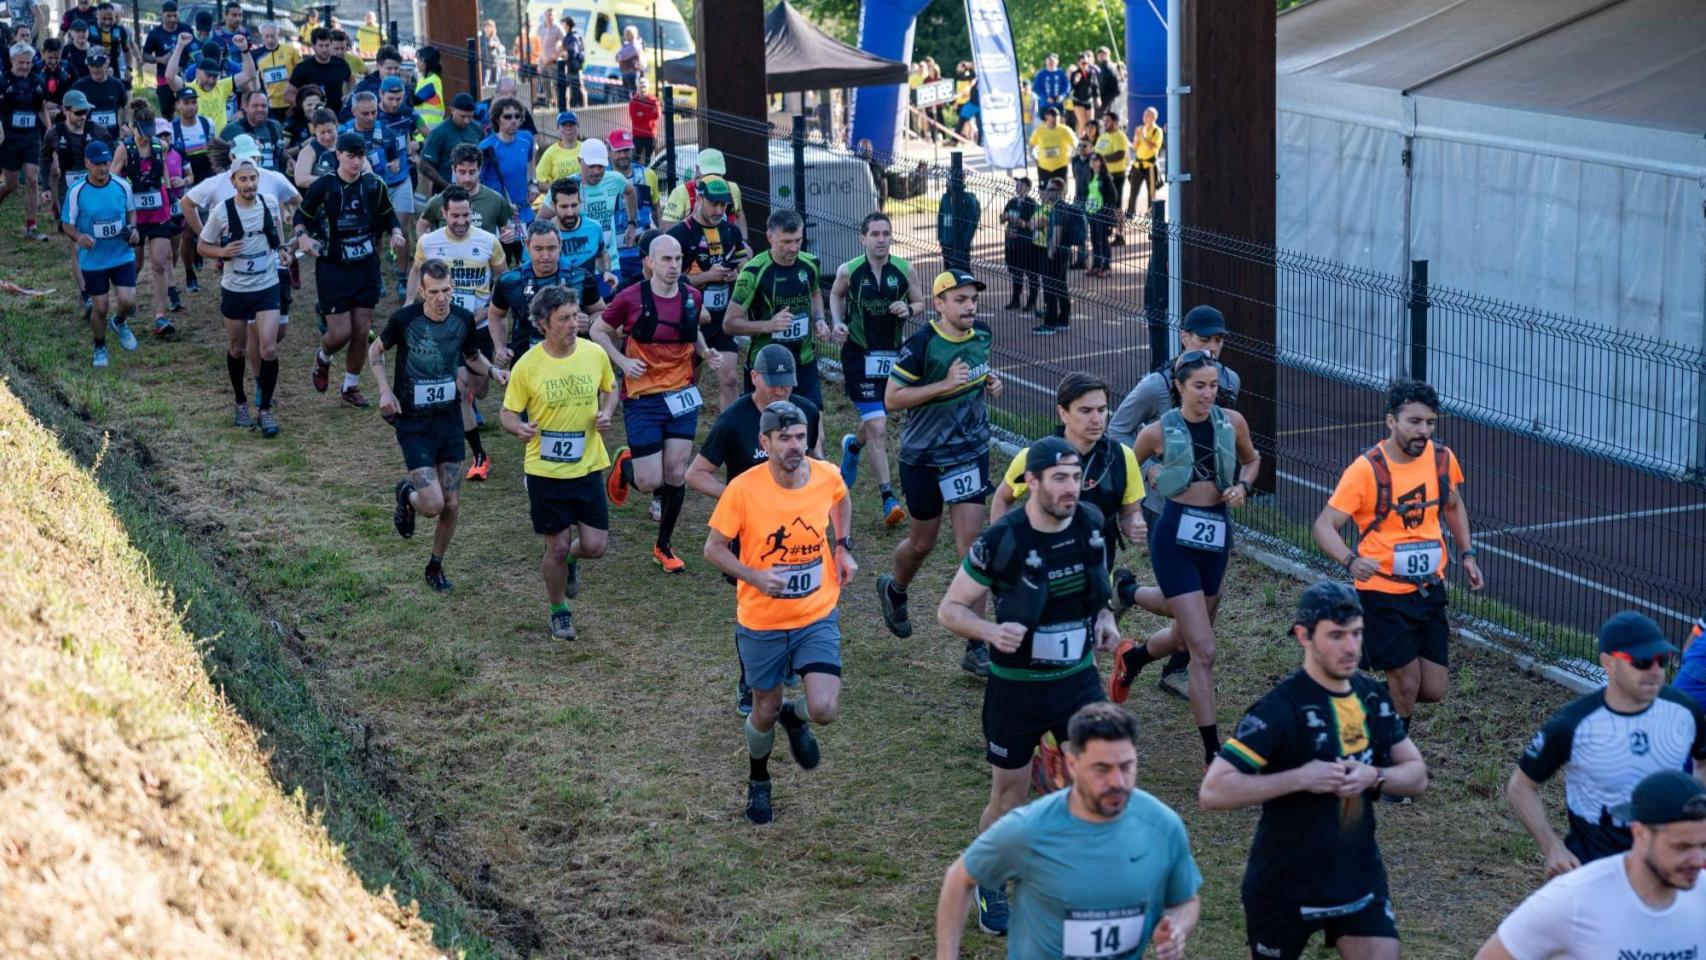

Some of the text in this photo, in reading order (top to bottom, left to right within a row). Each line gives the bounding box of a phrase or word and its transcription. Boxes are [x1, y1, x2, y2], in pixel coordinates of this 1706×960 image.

[20, 116, 30, 126] 61
[141, 196, 155, 206] 39
[103, 223, 116, 236] 88
[246, 261, 254, 271] 2
[877, 360, 890, 374] 76
[426, 387, 444, 402] 34
[676, 393, 694, 409] 70
[552, 441, 573, 457] 42
[954, 475, 972, 496] 92
[1192, 522, 1216, 544] 23
[1407, 554, 1430, 575] 93
[787, 573, 811, 592] 40
[1060, 637, 1069, 658] 1
[1091, 925, 1120, 953] 14
